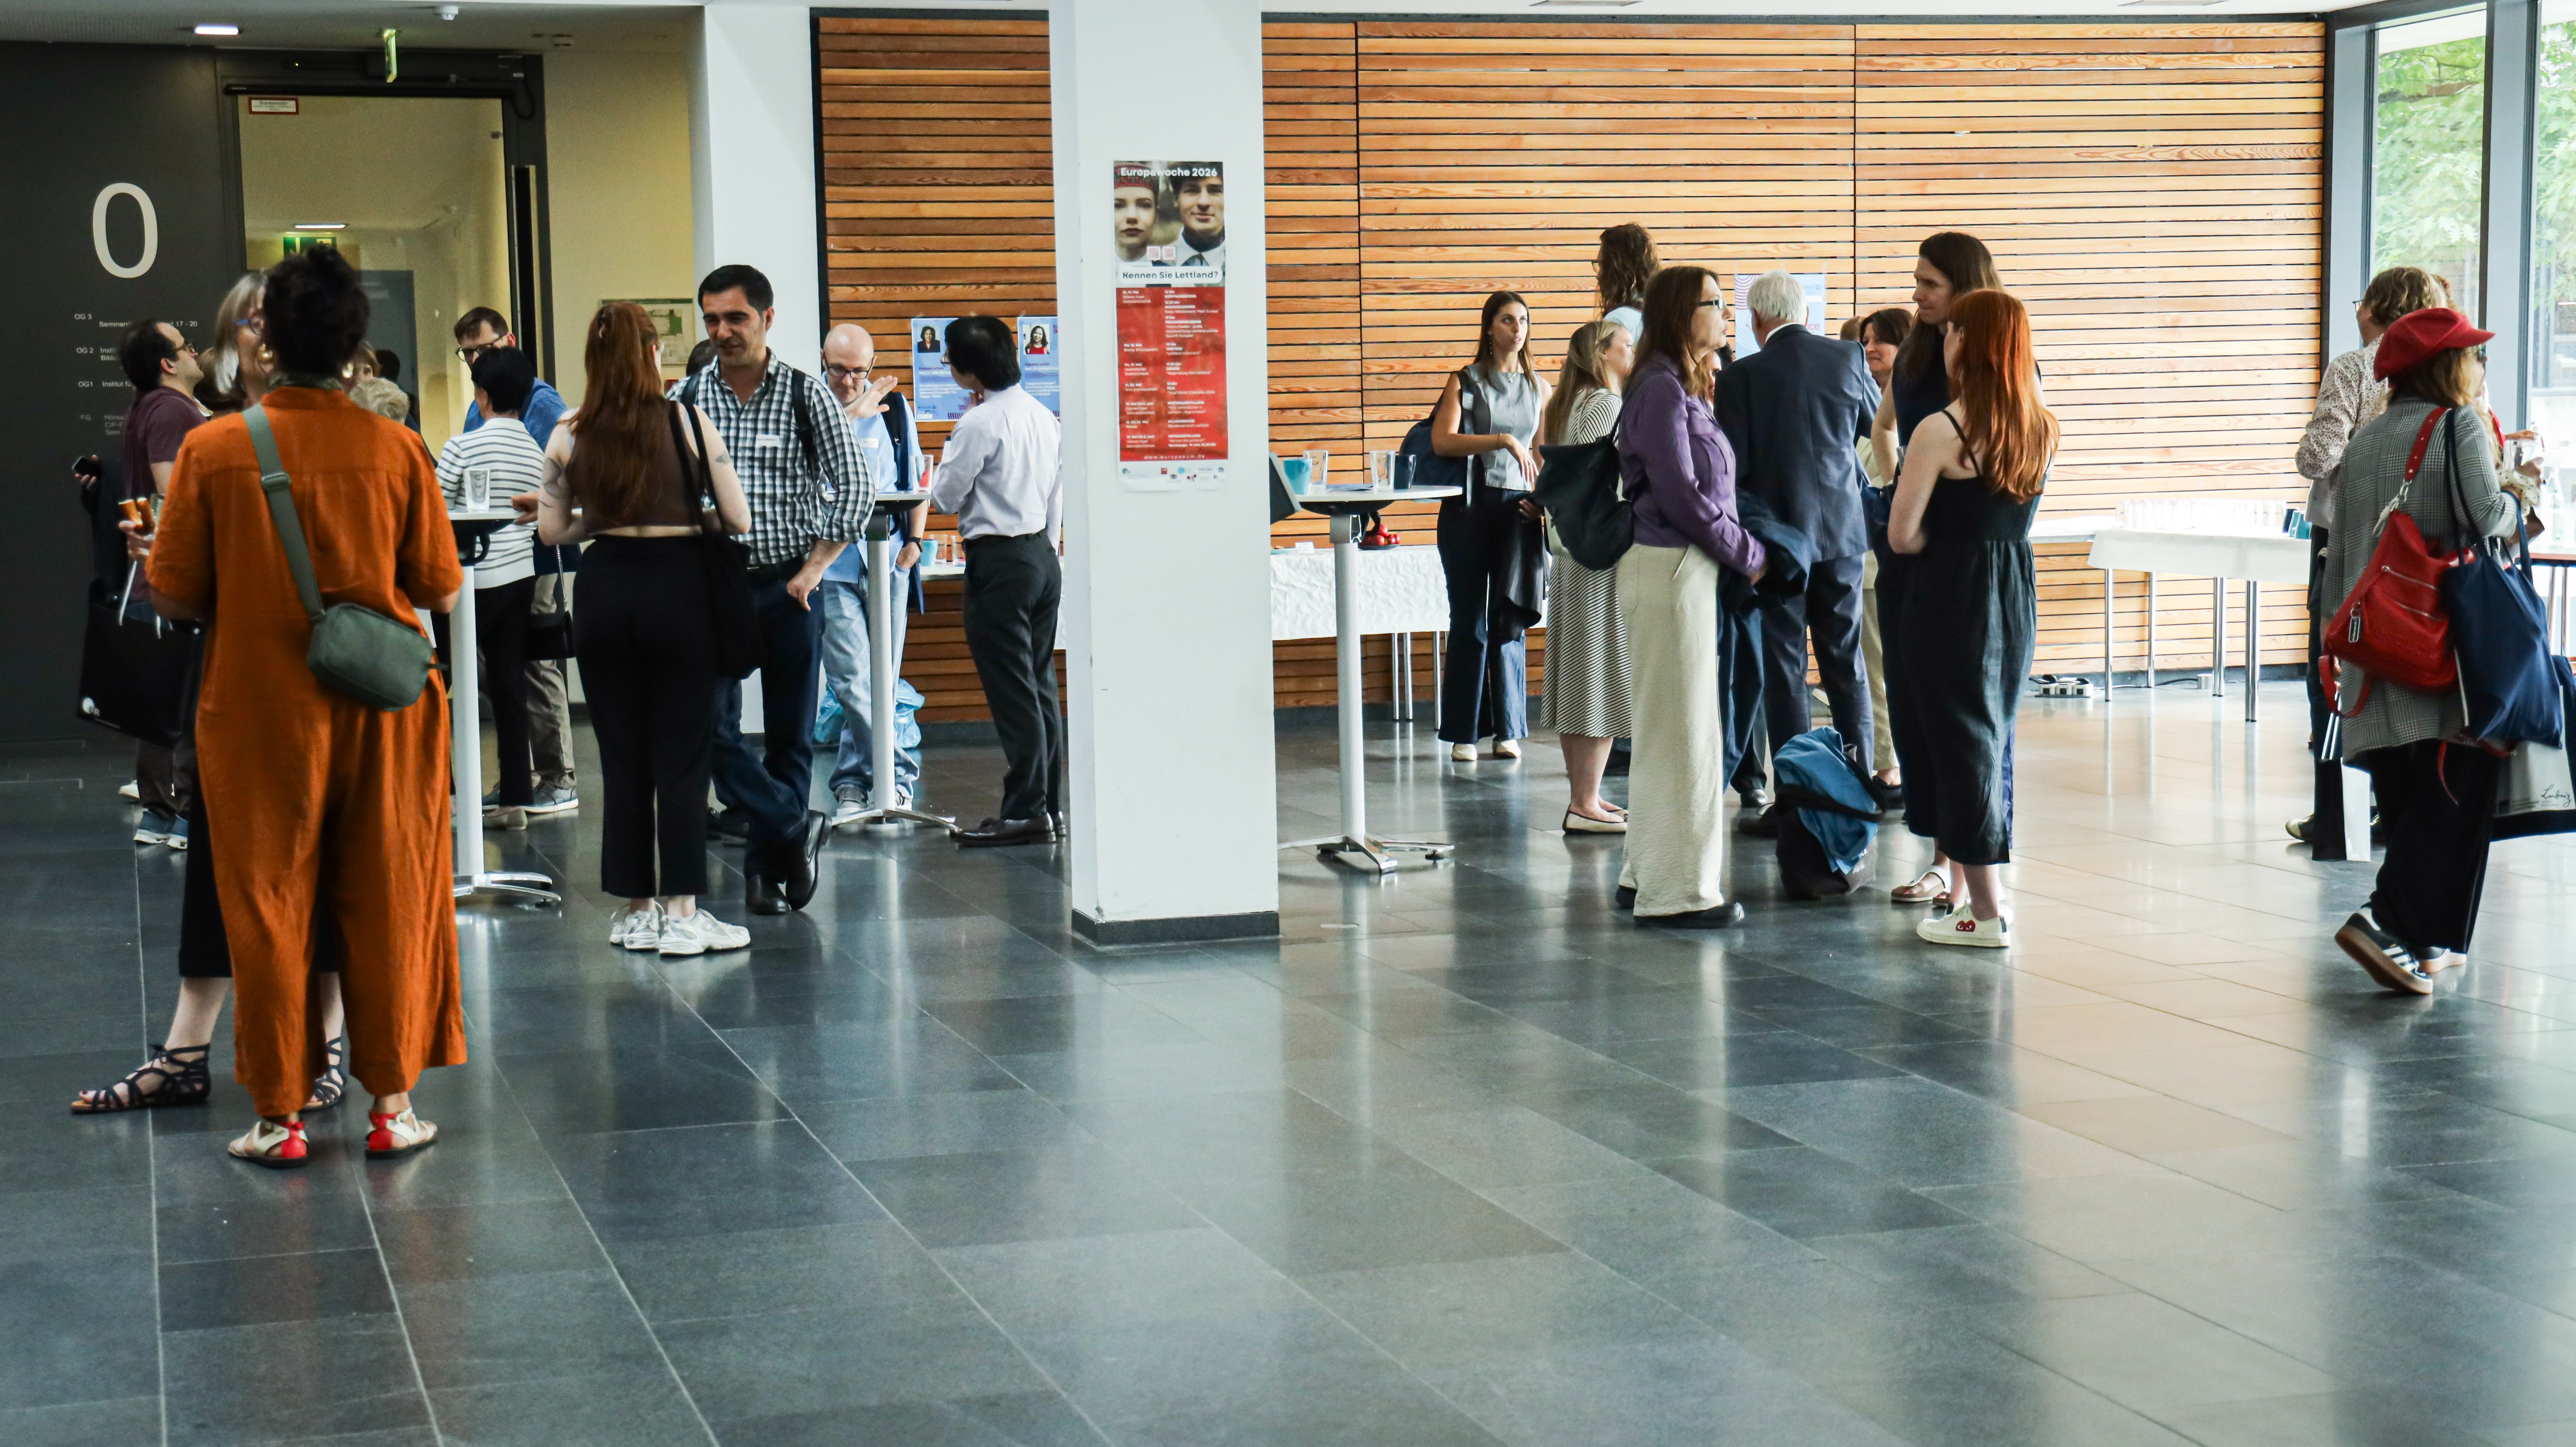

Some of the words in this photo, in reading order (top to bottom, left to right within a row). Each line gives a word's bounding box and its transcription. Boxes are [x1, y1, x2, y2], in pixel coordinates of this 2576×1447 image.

[1120, 168, 1189, 178] Europawoche
[1192, 168, 1217, 177] 2026
[2541, 784, 2572, 807] Leibniz
